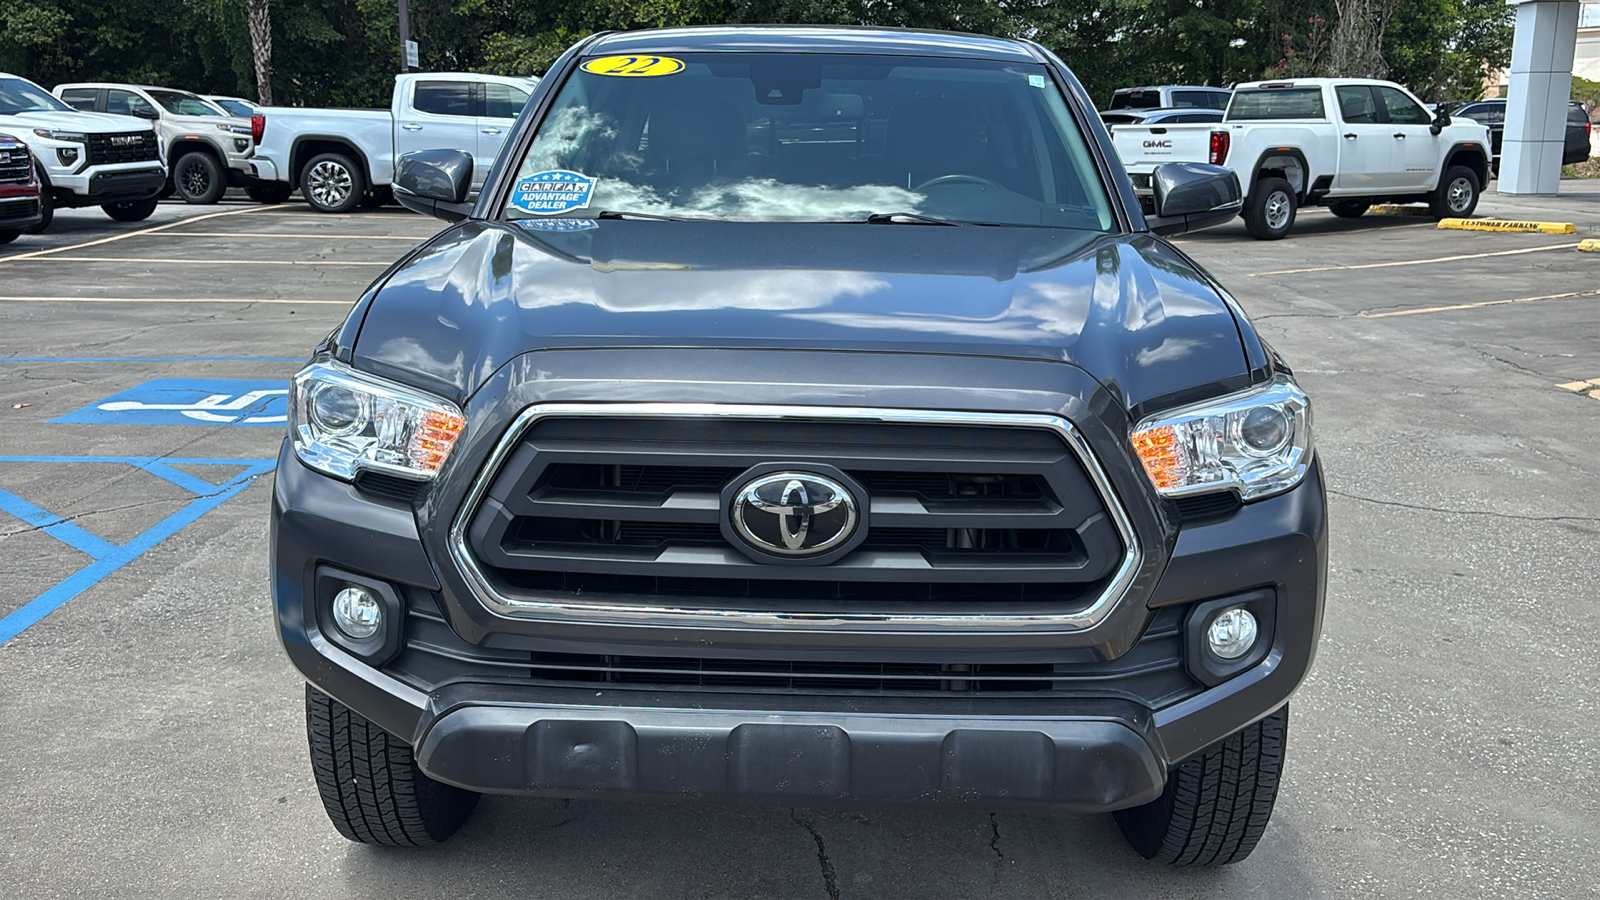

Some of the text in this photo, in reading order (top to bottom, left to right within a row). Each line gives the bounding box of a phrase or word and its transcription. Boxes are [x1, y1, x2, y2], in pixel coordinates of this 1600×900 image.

[603, 57, 661, 73] 22
[1142, 140, 1172, 148] GMC
[519, 182, 589, 192] CARFAX
[520, 193, 580, 201] ADVANTAGE
[528, 201, 567, 209] DEALER
[1502, 221, 1540, 229] PARKING
